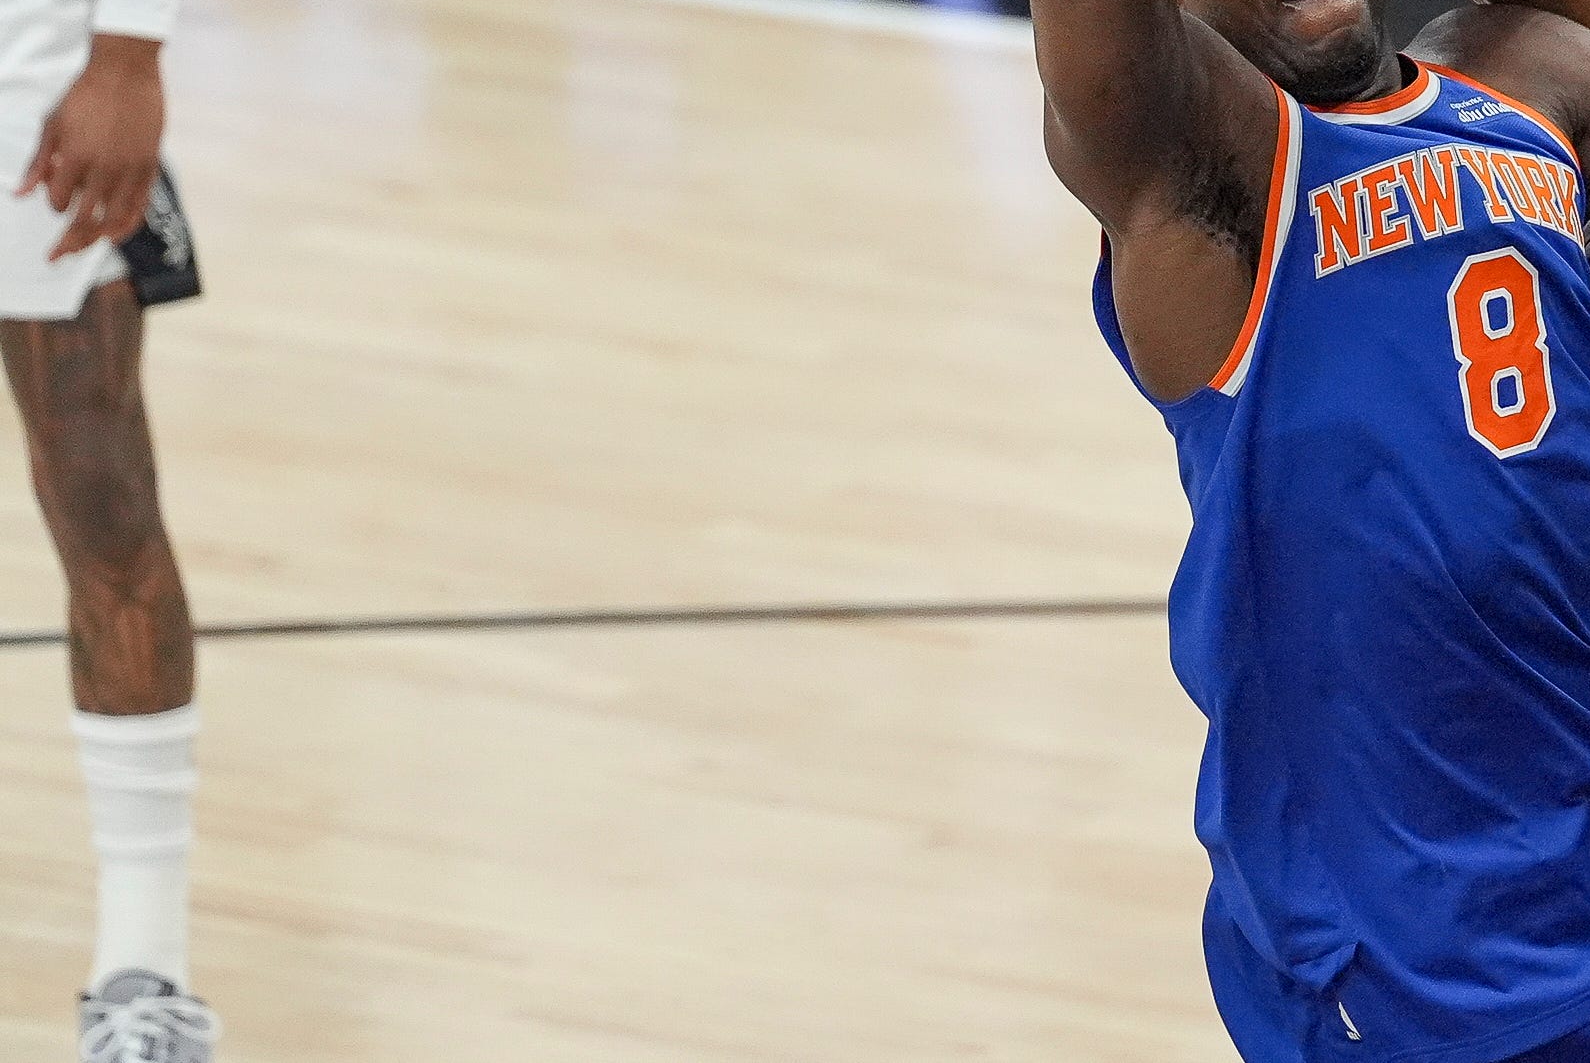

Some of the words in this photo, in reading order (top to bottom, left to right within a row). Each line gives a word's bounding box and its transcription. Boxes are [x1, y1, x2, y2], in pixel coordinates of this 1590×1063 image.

[1307, 143, 1464, 279] NEW
[1455, 144, 1586, 252] YORK
[1447, 245, 1557, 459] 8
